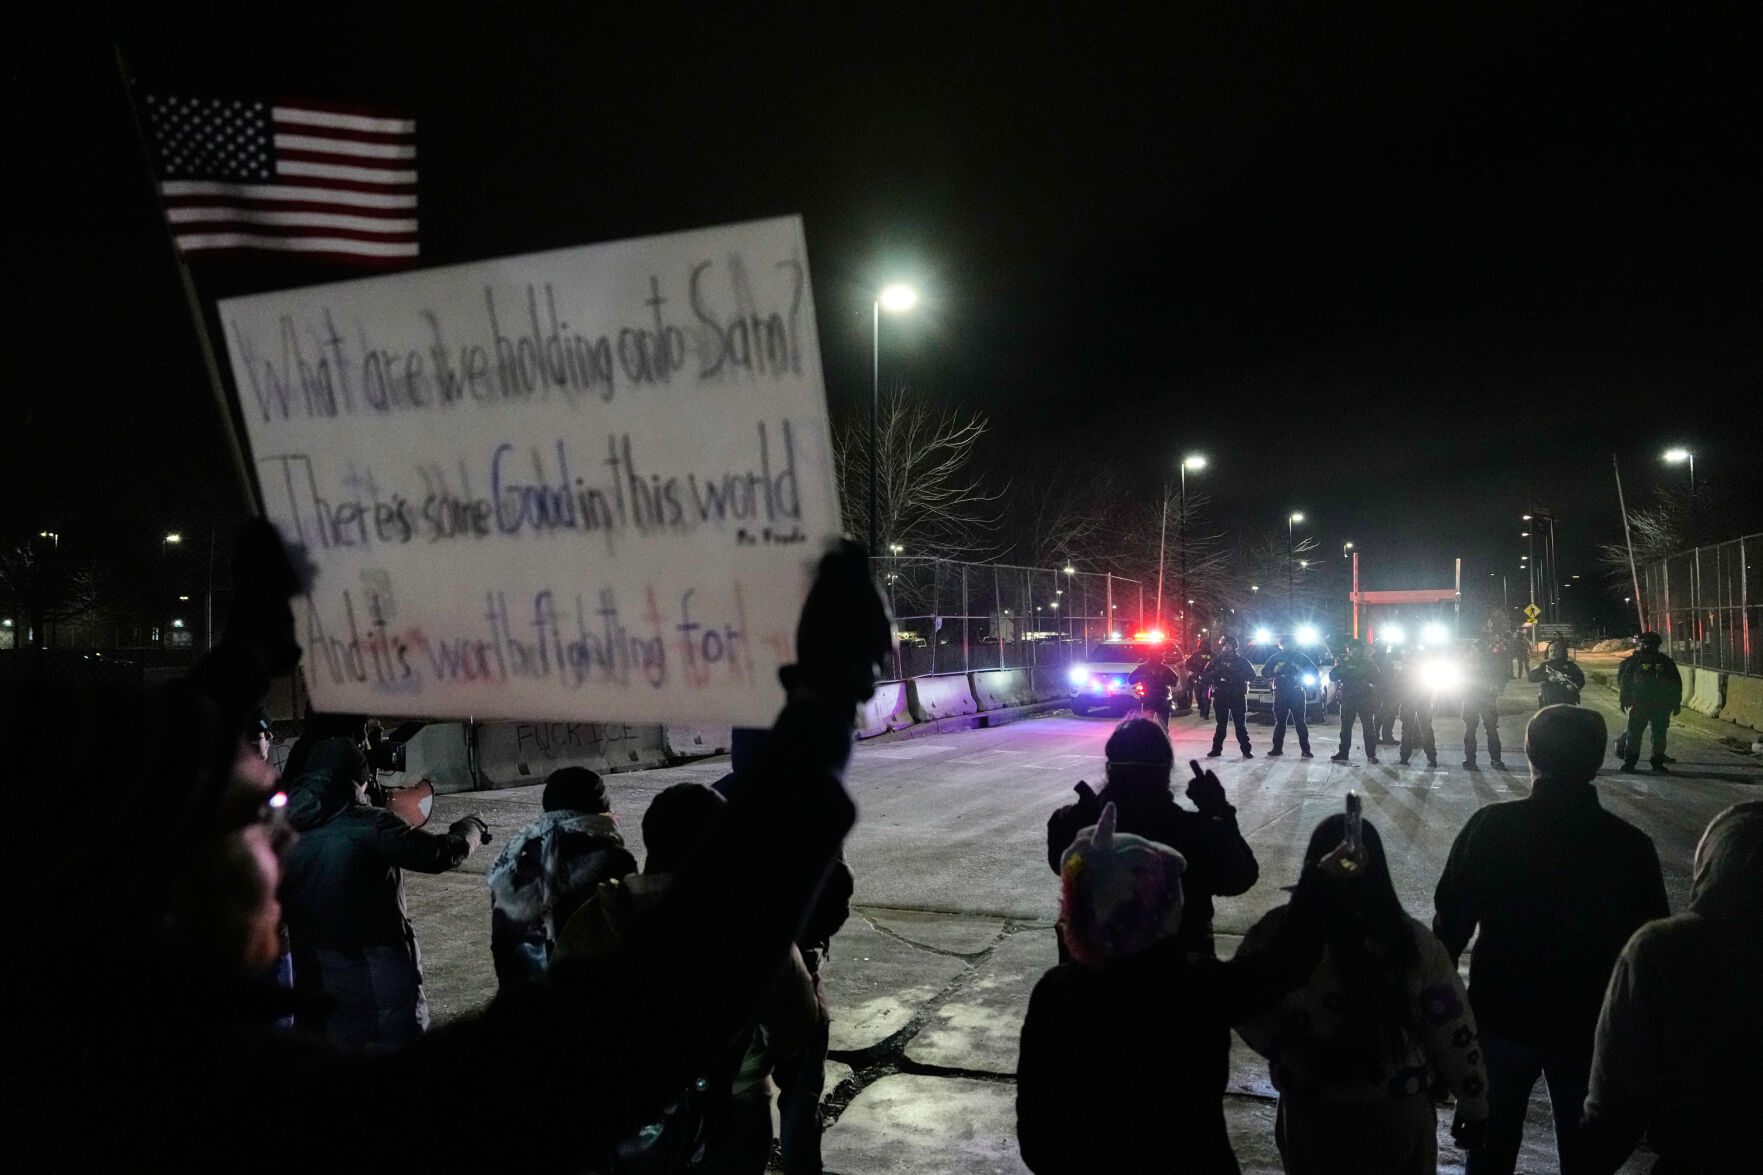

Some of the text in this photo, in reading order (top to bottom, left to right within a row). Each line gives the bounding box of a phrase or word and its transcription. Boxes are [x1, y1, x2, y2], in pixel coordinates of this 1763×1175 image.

[232, 305, 353, 423] What
[362, 347, 427, 413] are
[433, 342, 491, 403] we
[484, 284, 614, 401] holding
[690, 257, 803, 380] Sam?
[256, 418, 801, 548] There's some Good in this world
[305, 590, 368, 688] And
[428, 590, 530, 683] worth
[530, 589, 667, 690] fighting
[517, 720, 639, 753] FUCK ICE
